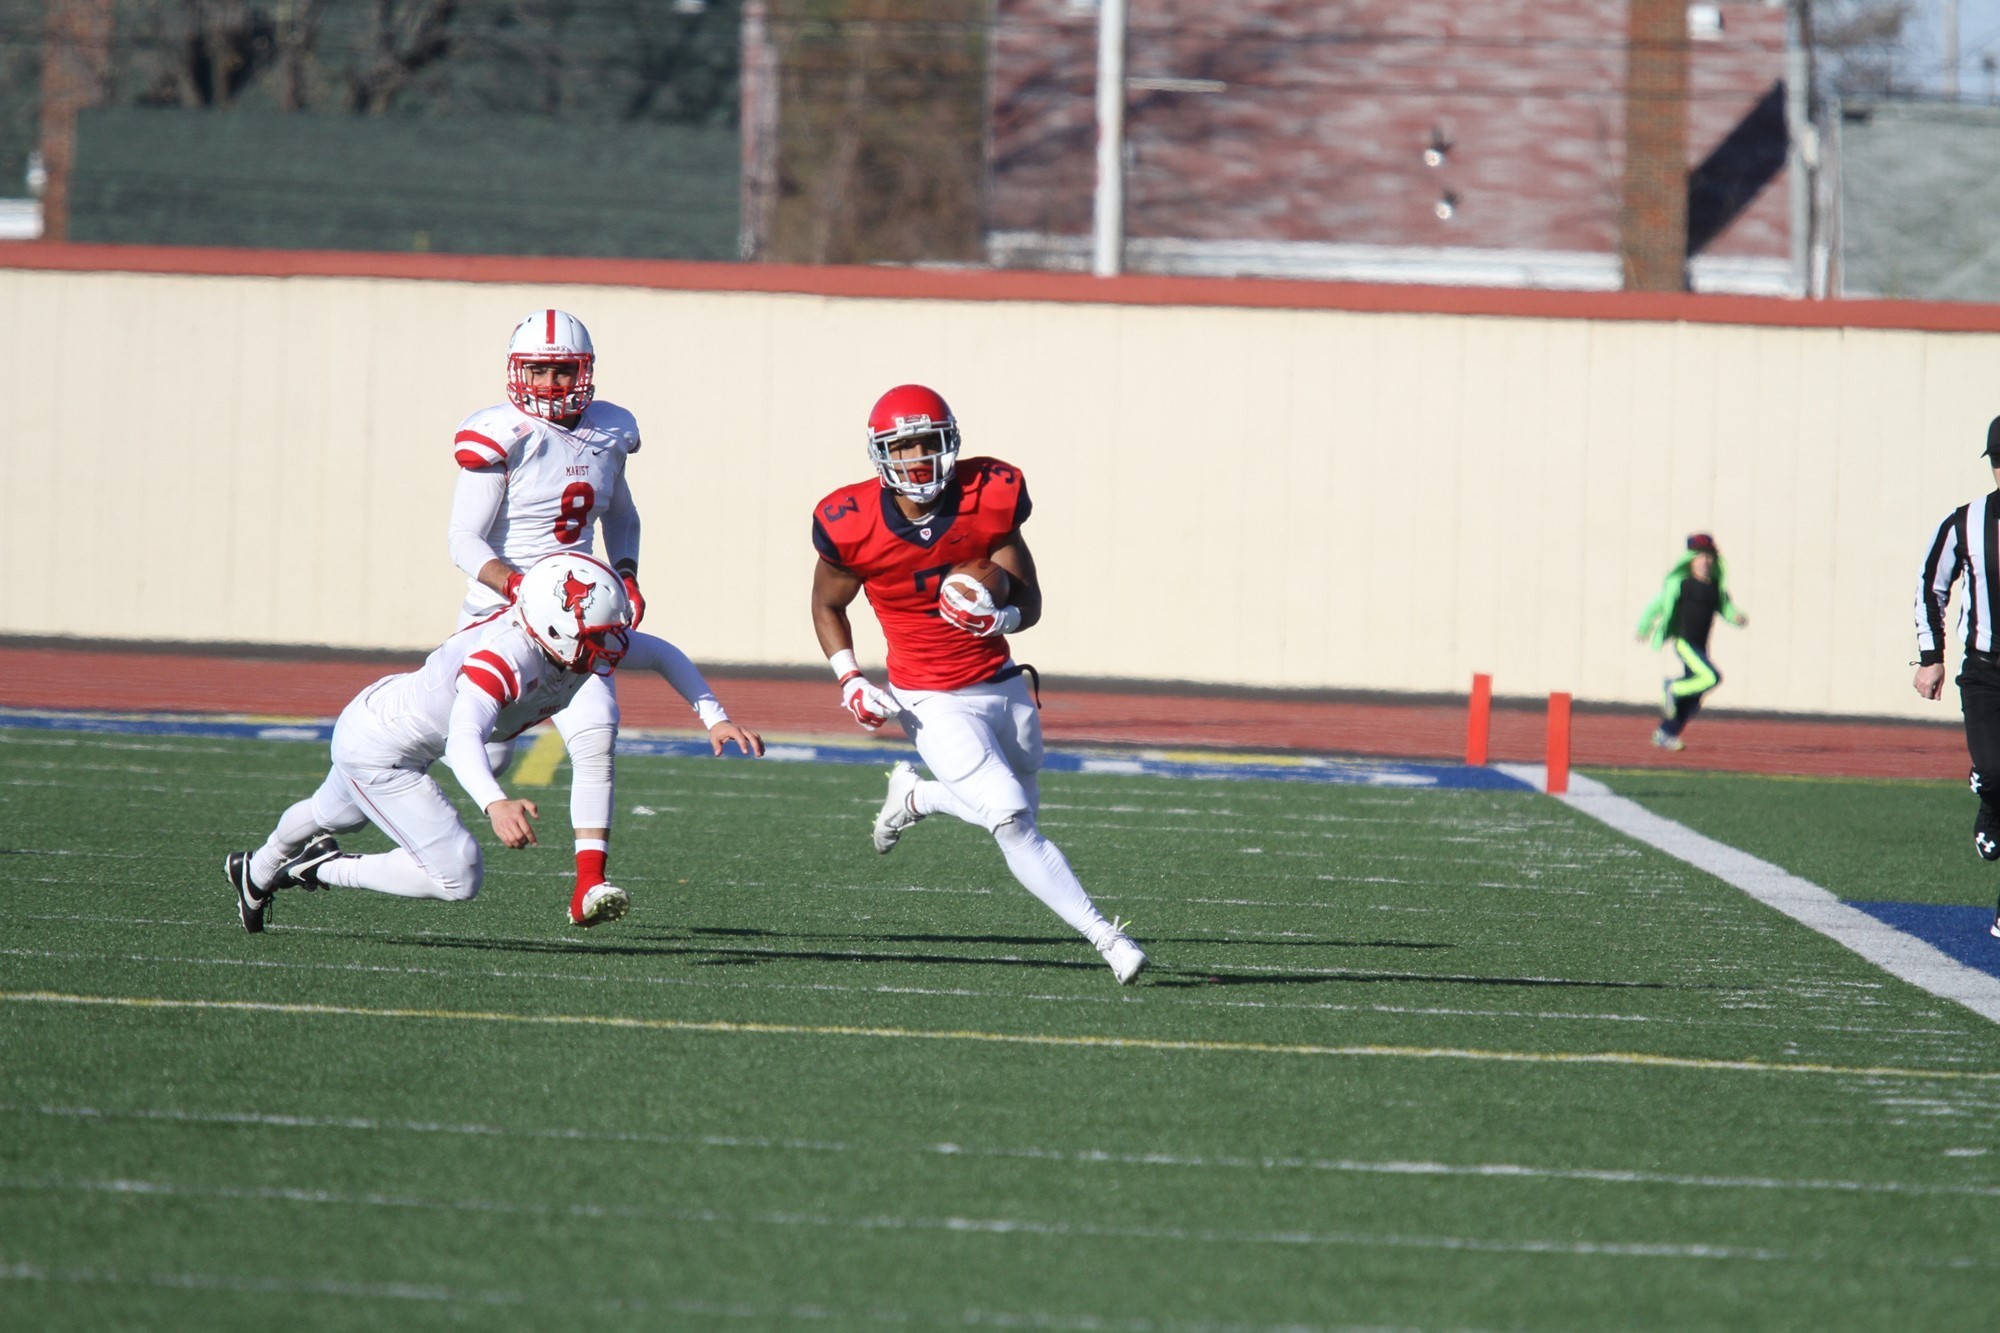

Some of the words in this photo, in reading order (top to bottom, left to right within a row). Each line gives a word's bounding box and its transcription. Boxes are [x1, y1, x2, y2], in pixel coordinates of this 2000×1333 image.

[565, 465, 589, 476] MARIST
[553, 482, 595, 544] 8
[824, 496, 860, 522] 3
